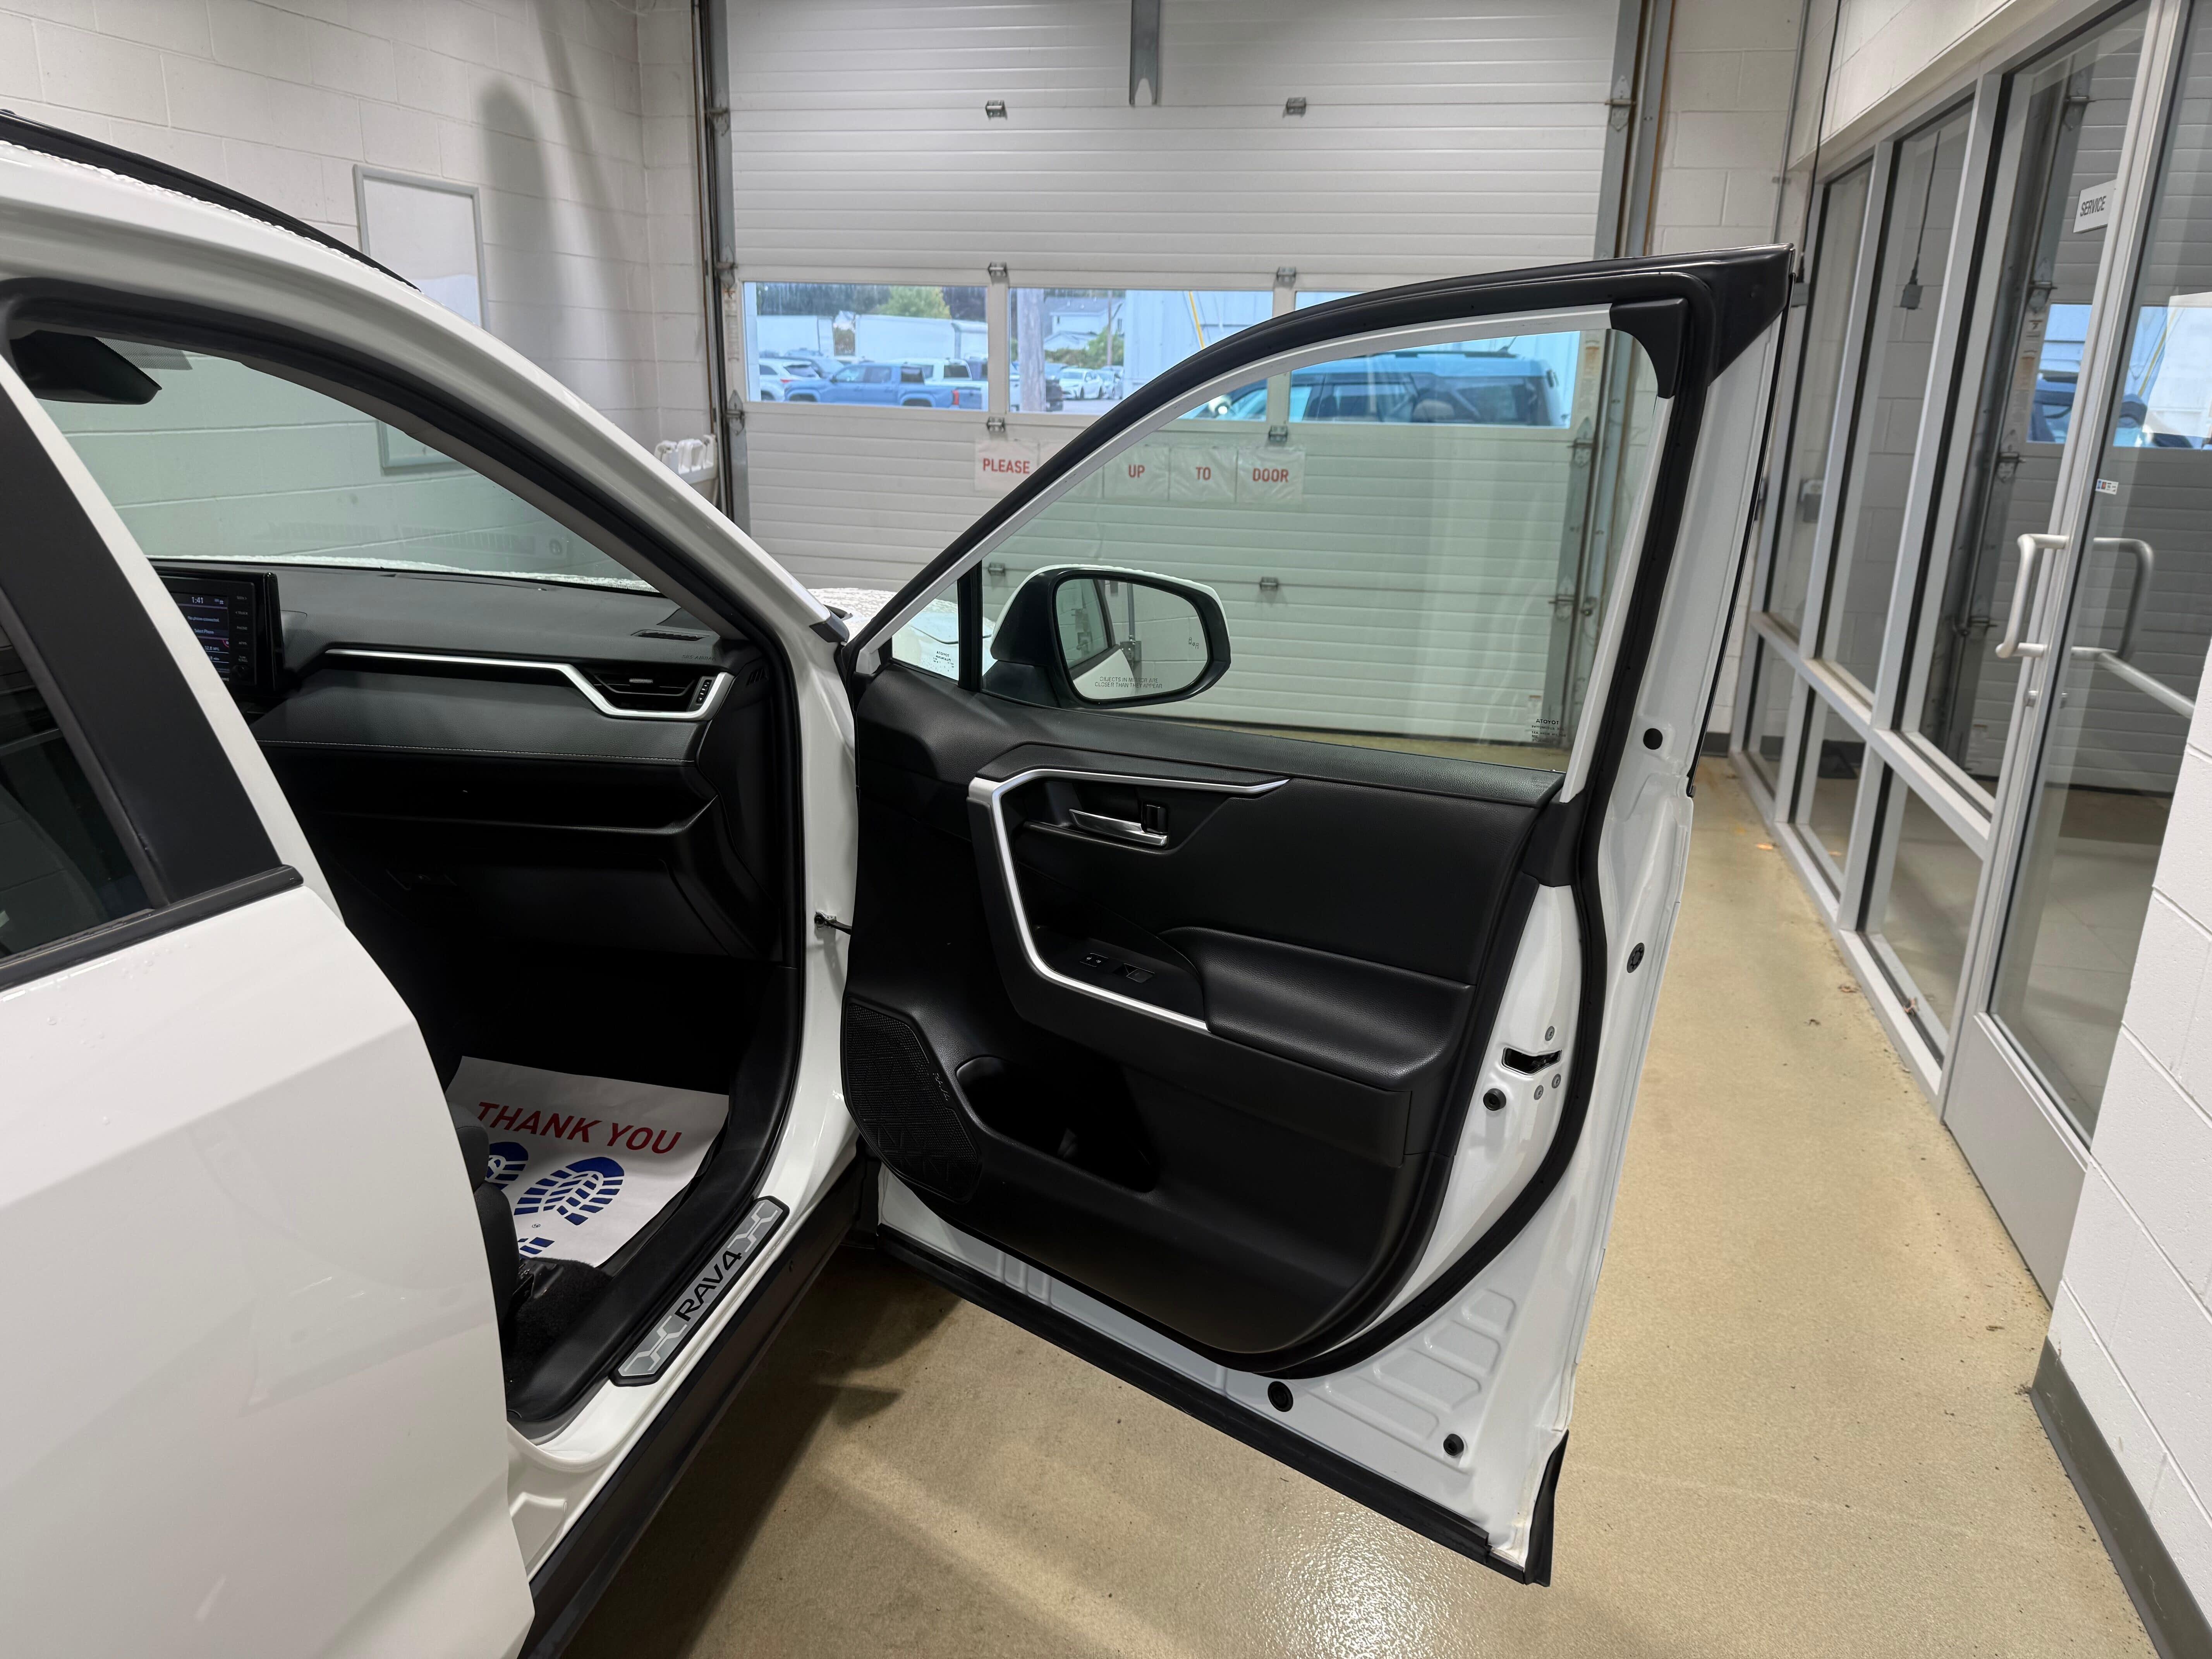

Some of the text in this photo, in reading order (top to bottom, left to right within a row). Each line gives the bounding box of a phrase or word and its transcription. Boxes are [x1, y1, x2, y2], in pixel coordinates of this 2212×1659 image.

[2080, 195, 2107, 217] SERVICE
[982, 458, 1289, 483] PLEASE UP TO DOOR
[477, 1101, 682, 1154] THANK YOU
[675, 1250, 742, 1322] RAV4
